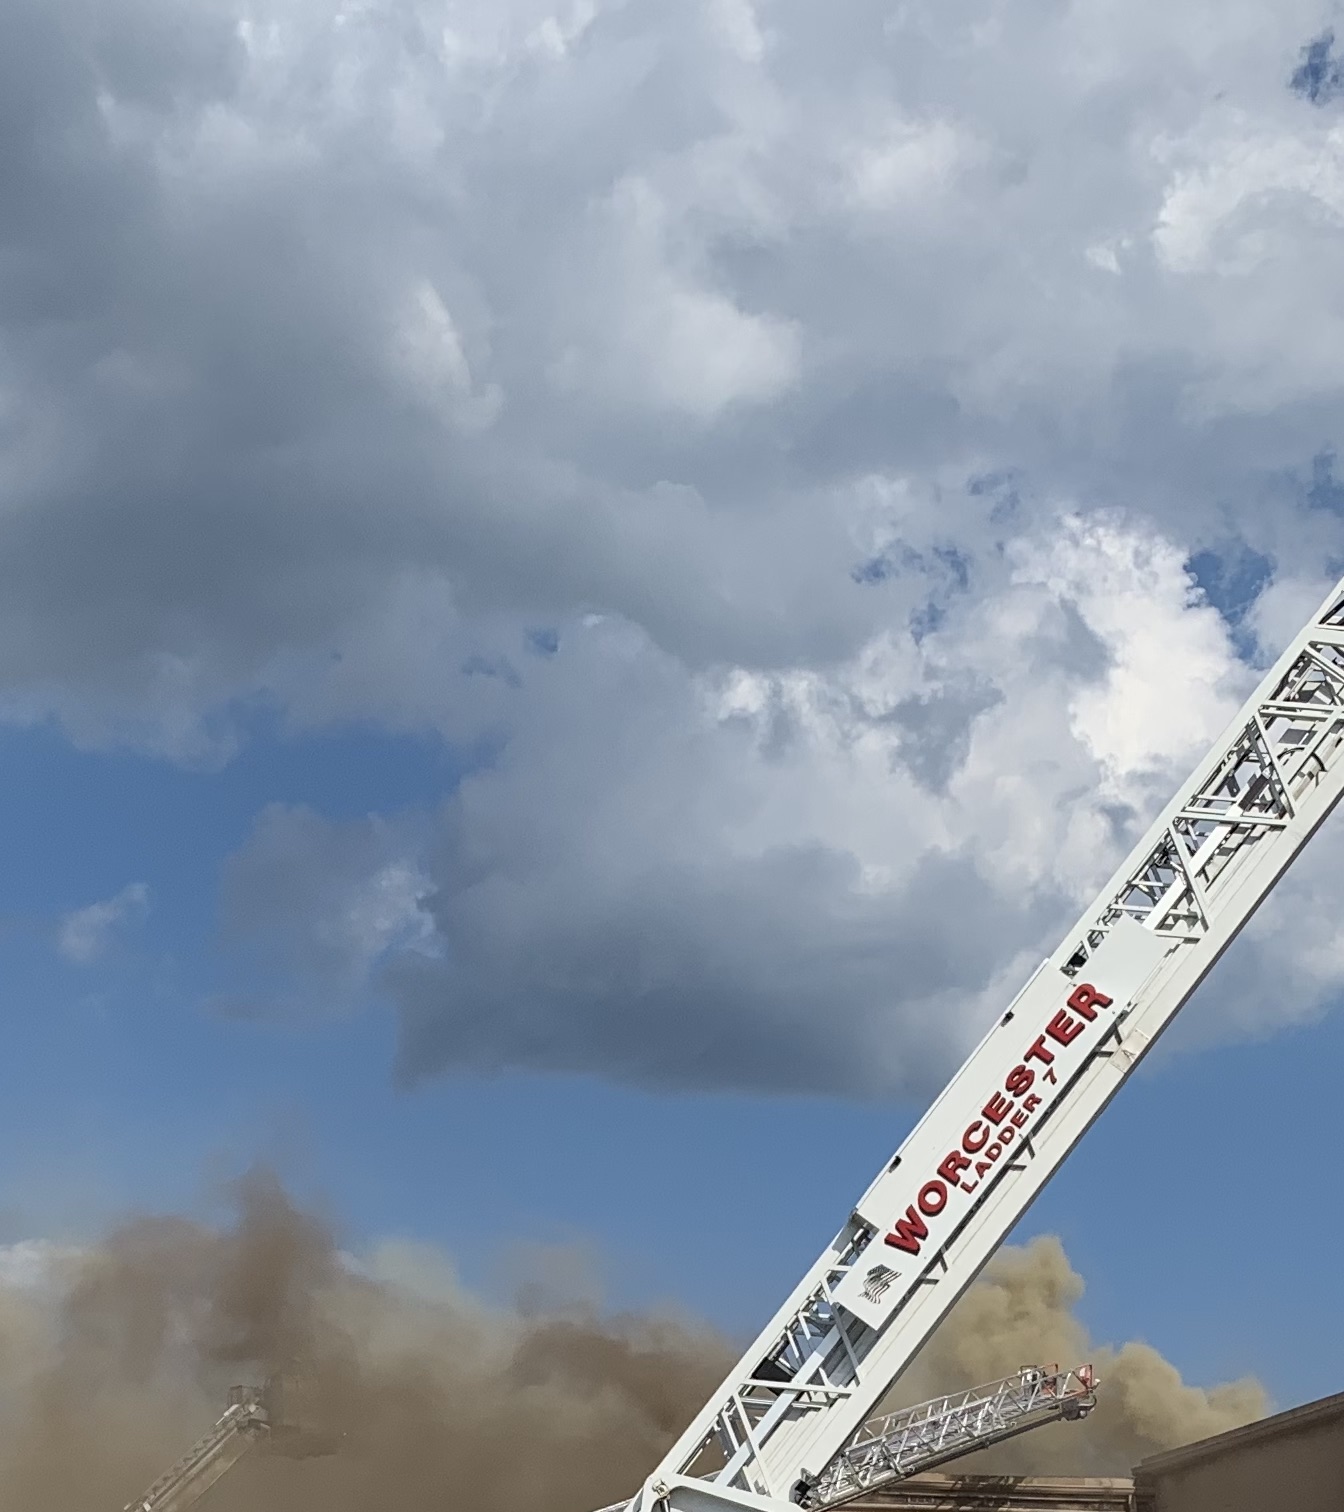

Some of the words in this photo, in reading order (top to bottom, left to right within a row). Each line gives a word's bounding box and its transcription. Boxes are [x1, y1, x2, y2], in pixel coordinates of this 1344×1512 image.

[884, 983, 1113, 1256] WORCESTER
[960, 1093, 1042, 1194] LADDER
[1042, 1067, 1057, 1085] 7
